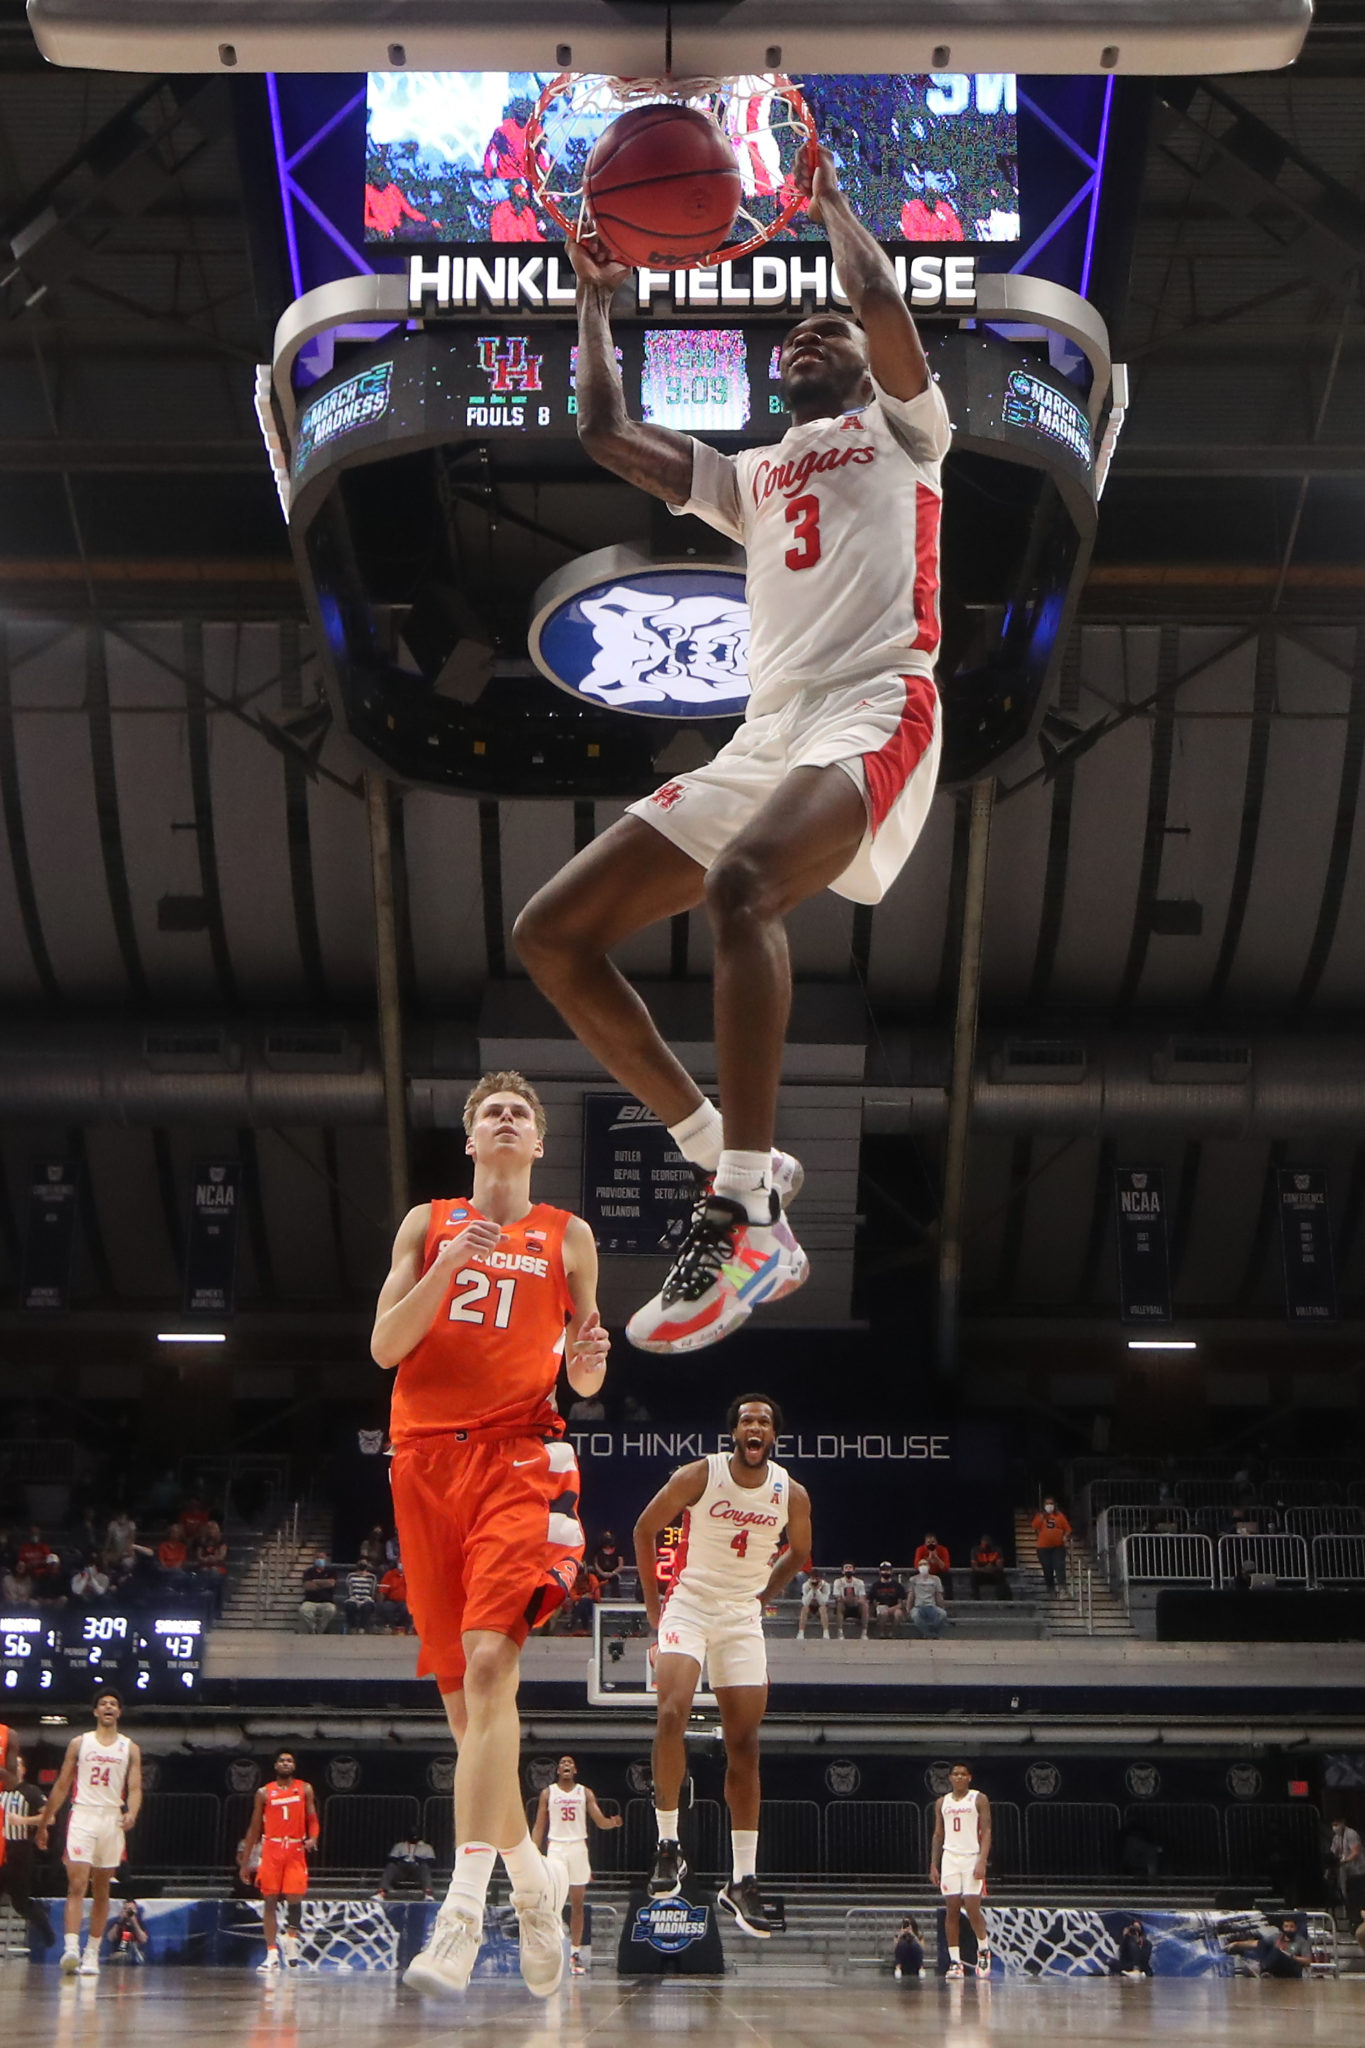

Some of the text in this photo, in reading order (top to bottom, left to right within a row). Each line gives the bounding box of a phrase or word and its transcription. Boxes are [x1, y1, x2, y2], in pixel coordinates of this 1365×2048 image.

[409, 255, 577, 301] HINKL
[665, 375, 728, 405] 3:09
[311, 381, 358, 426] MARCH
[1031, 381, 1077, 427] MARCH
[314, 391, 387, 444] MADNESS
[466, 406, 525, 426] FOULS
[752, 446, 875, 511] Cougars
[785, 494, 821, 571] 3
[614, 1150, 641, 1162] BUTLER
[196, 1184, 235, 1206] NCAA
[596, 1186, 641, 1199] PROVIDENCE
[1121, 1191, 1160, 1212] NCAA
[601, 1204, 641, 1217] VILLANOVA
[449, 1268, 517, 1329] 21
[569, 1433, 612, 1456] TO
[709, 1500, 778, 1527] Cougars
[730, 1529, 749, 1558] 4
[83, 1617, 127, 1640] 3:09
[4, 1633, 31, 1657] 56
[89, 1646, 102, 1664] 2
[165, 1635, 194, 1658] 43
[5, 1669, 18, 1689] 8
[40, 1670, 52, 1689] 3
[136, 1671, 150, 1689] 2
[181, 1671, 194, 1689] 9
[90, 1766, 111, 1787] 24
[281, 1804, 289, 1821] 1
[560, 1806, 576, 1822] 35
[953, 1816, 961, 1833] 0
[649, 1909, 688, 1922] MARCH
[653, 1921, 705, 1934] MADNESS
